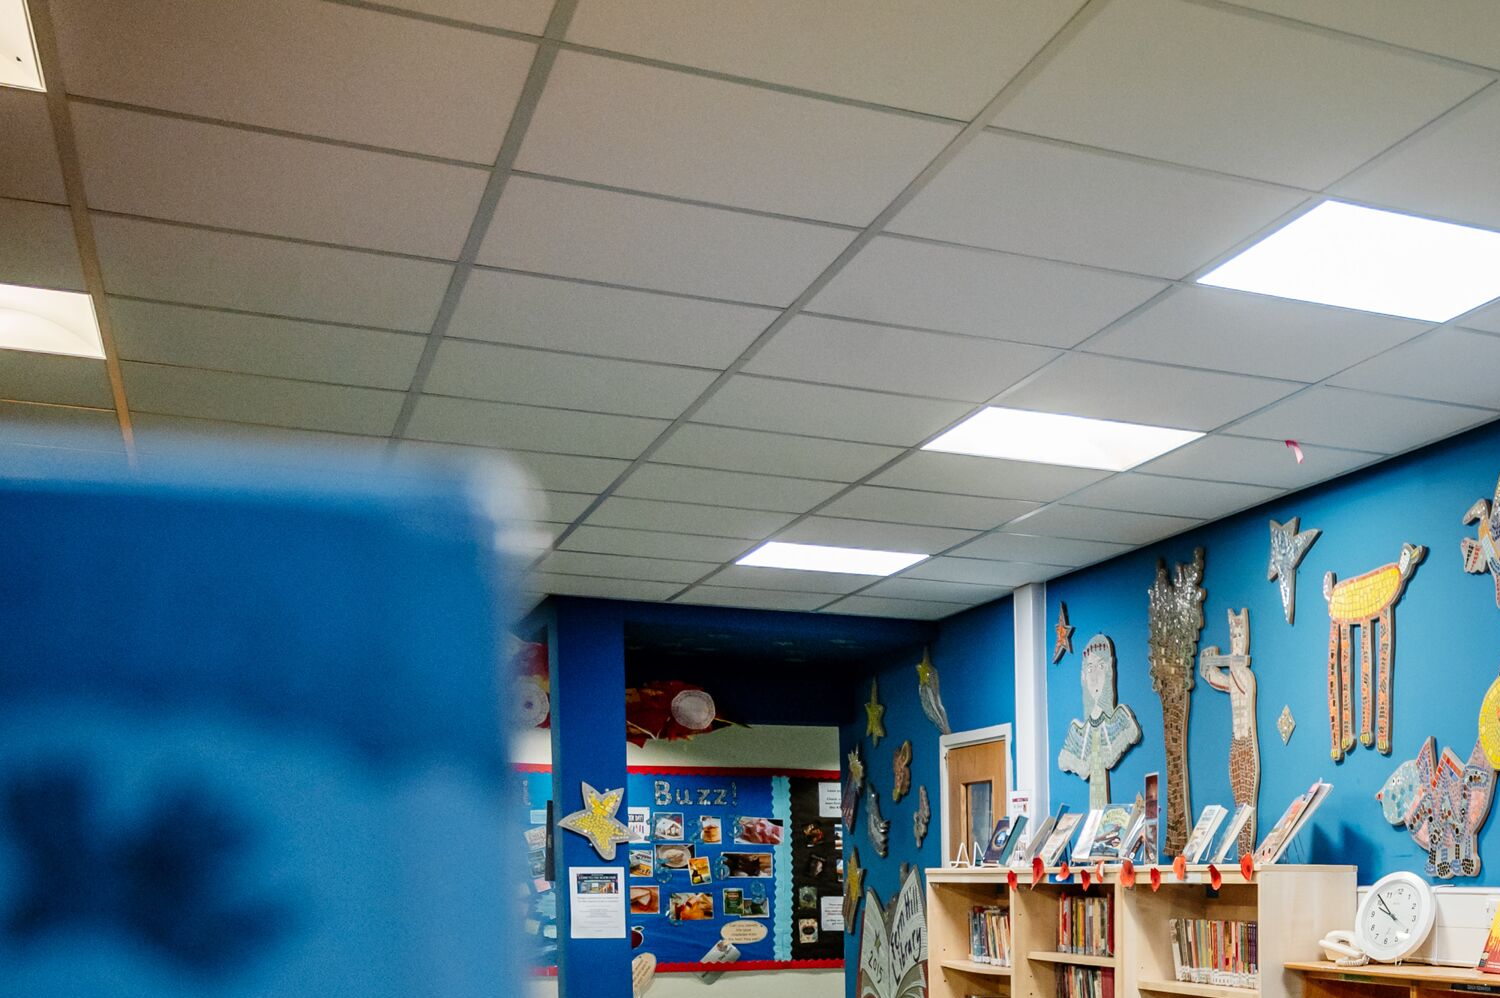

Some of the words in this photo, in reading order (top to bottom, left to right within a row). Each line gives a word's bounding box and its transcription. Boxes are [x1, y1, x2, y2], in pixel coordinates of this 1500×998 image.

[654, 780, 737, 806] Buzz!
[904, 885, 919, 920] Hill
[868, 951, 882, 984] 2015
[892, 927, 921, 985] Library
